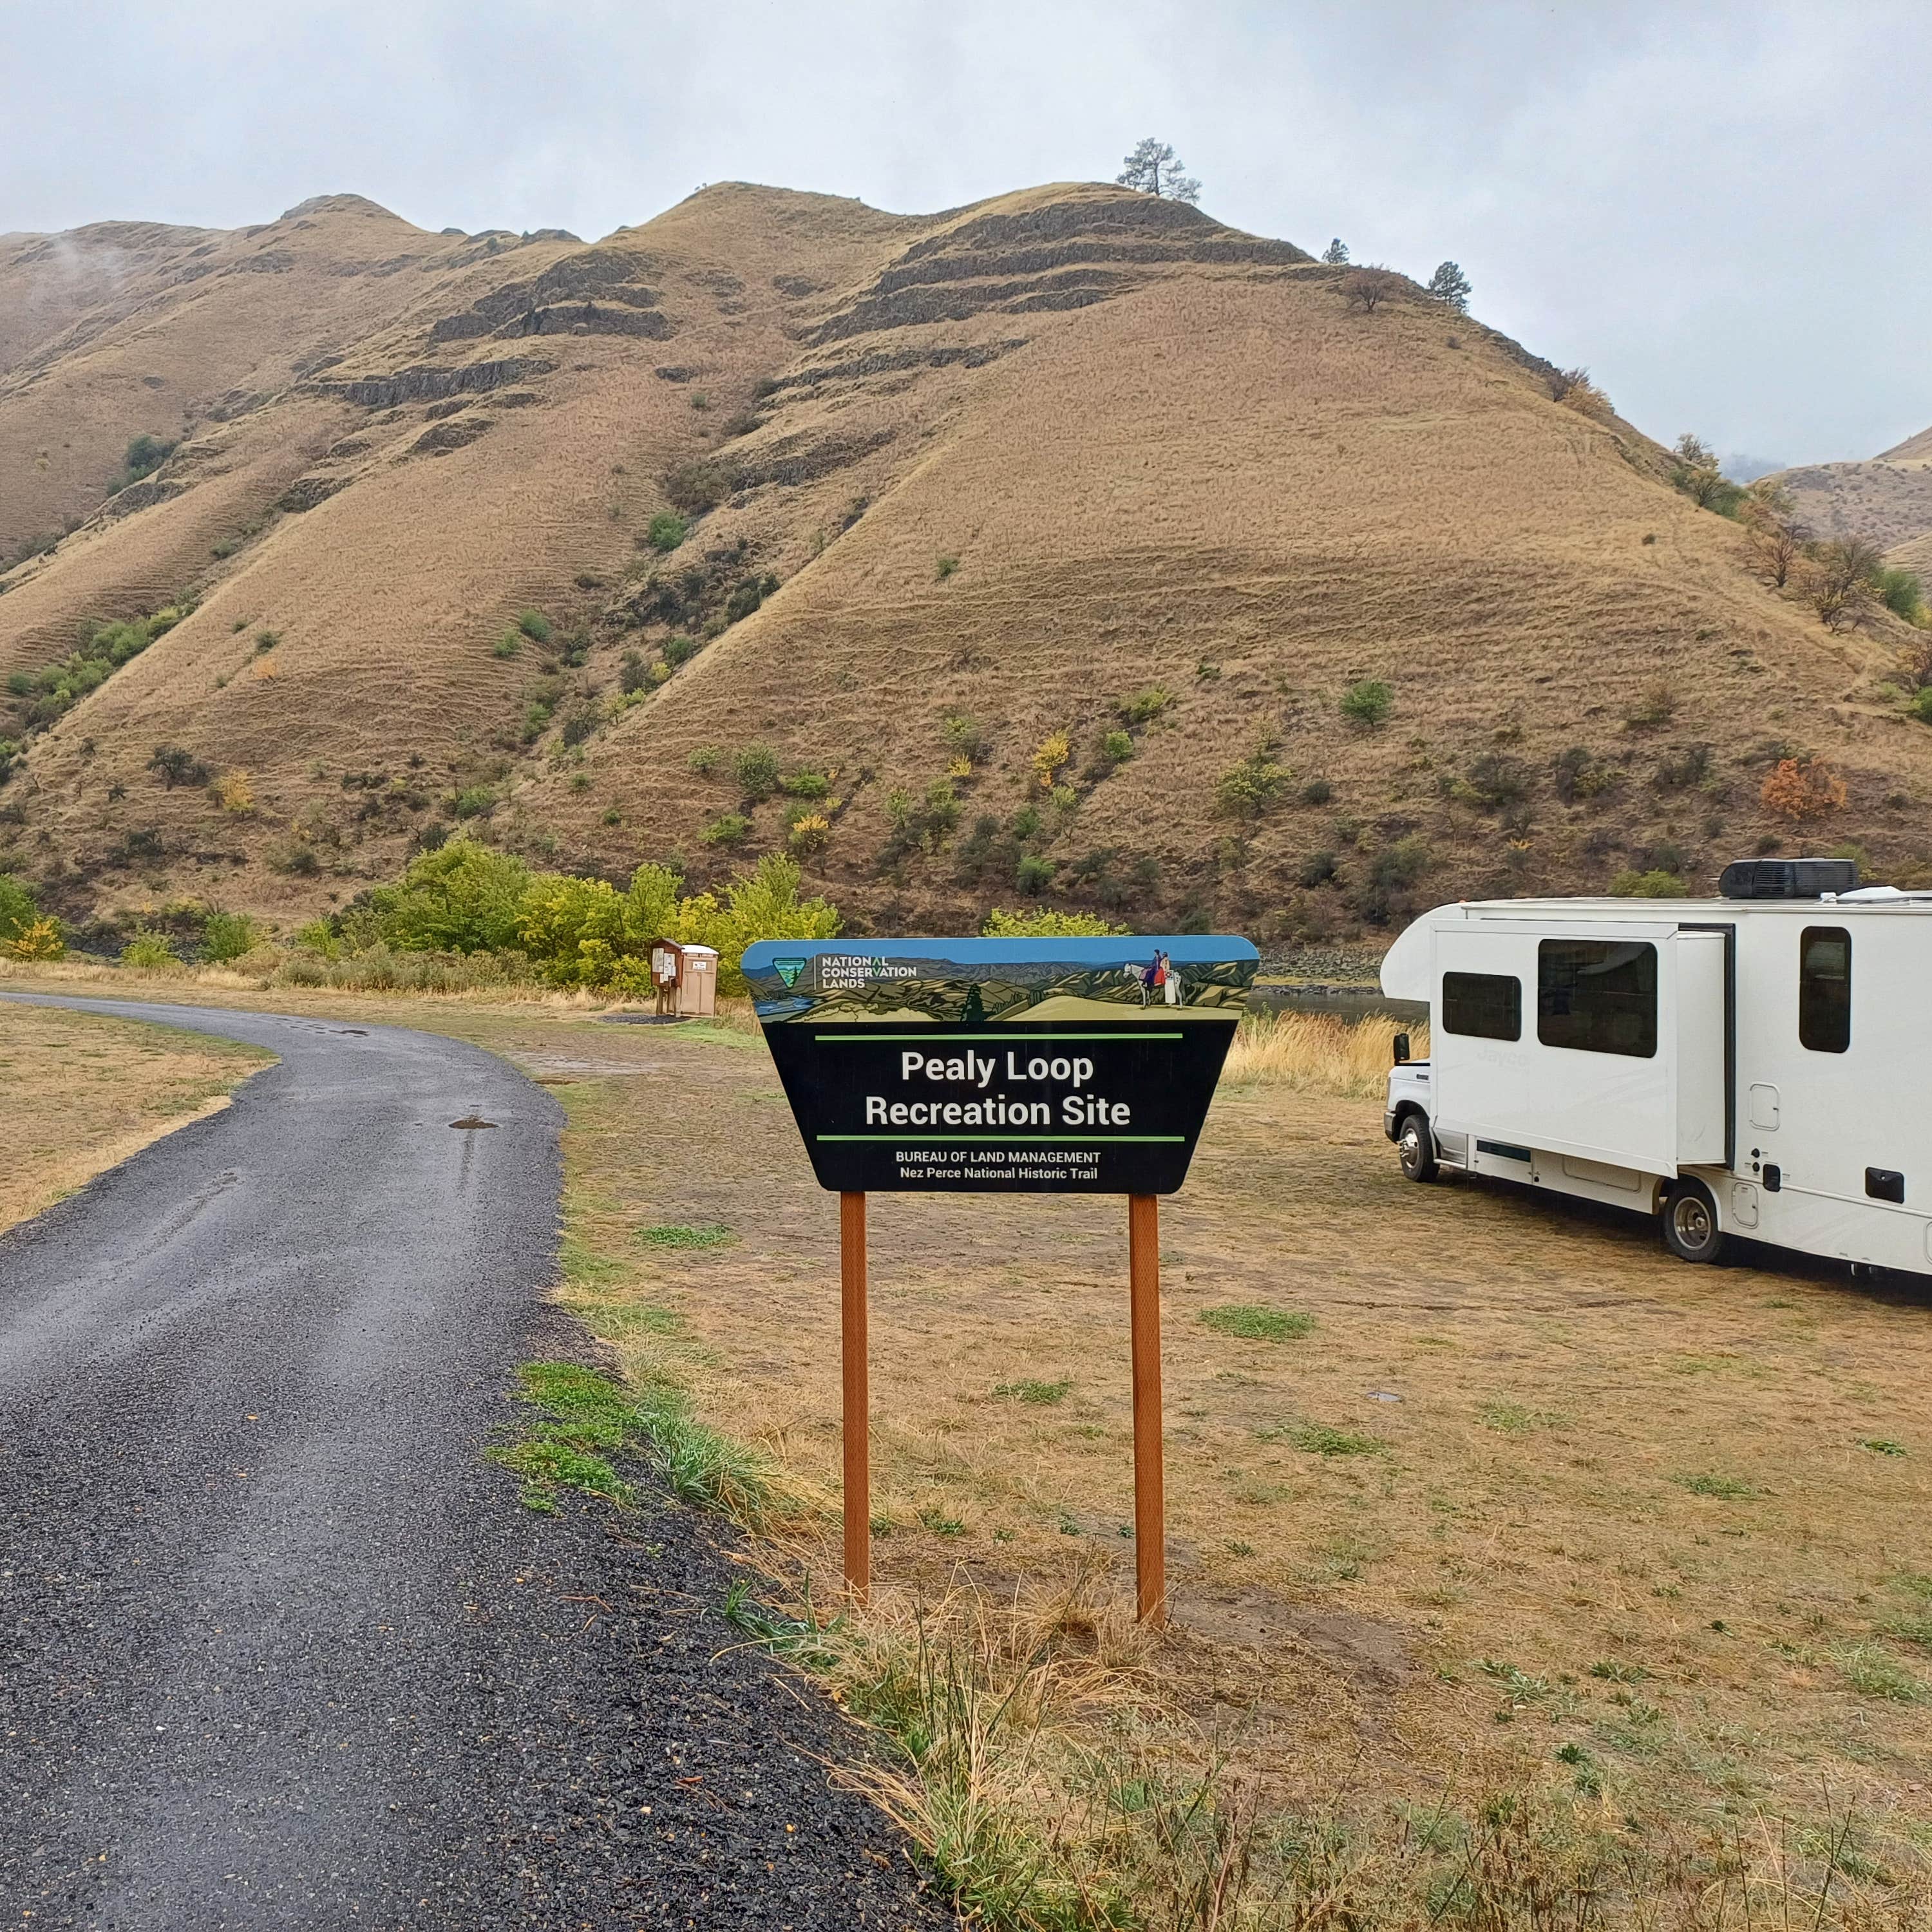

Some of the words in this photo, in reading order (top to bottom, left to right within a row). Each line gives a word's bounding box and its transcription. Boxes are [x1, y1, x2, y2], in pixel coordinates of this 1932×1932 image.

[822, 956, 889, 967] NATIONAL
[821, 967, 917, 978] CONSERVATION
[822, 978, 865, 989] LANDS
[902, 1049, 996, 1088] Pealy
[1007, 1050, 1094, 1088] Loop
[866, 1094, 1050, 1126] Recreation
[1062, 1094, 1131, 1126] Site
[896, 1151, 947, 1163] BUREAU
[951, 1151, 967, 1163] OF
[970, 1151, 1005, 1163] LAND
[1008, 1151, 1102, 1163] MANAGEMENT
[900, 1167, 924, 1179] Nez
[927, 1167, 961, 1179] Perce
[964, 1167, 1015, 1179] National
[1018, 1167, 1067, 1179] Historic
[1069, 1167, 1098, 1180] Trail
